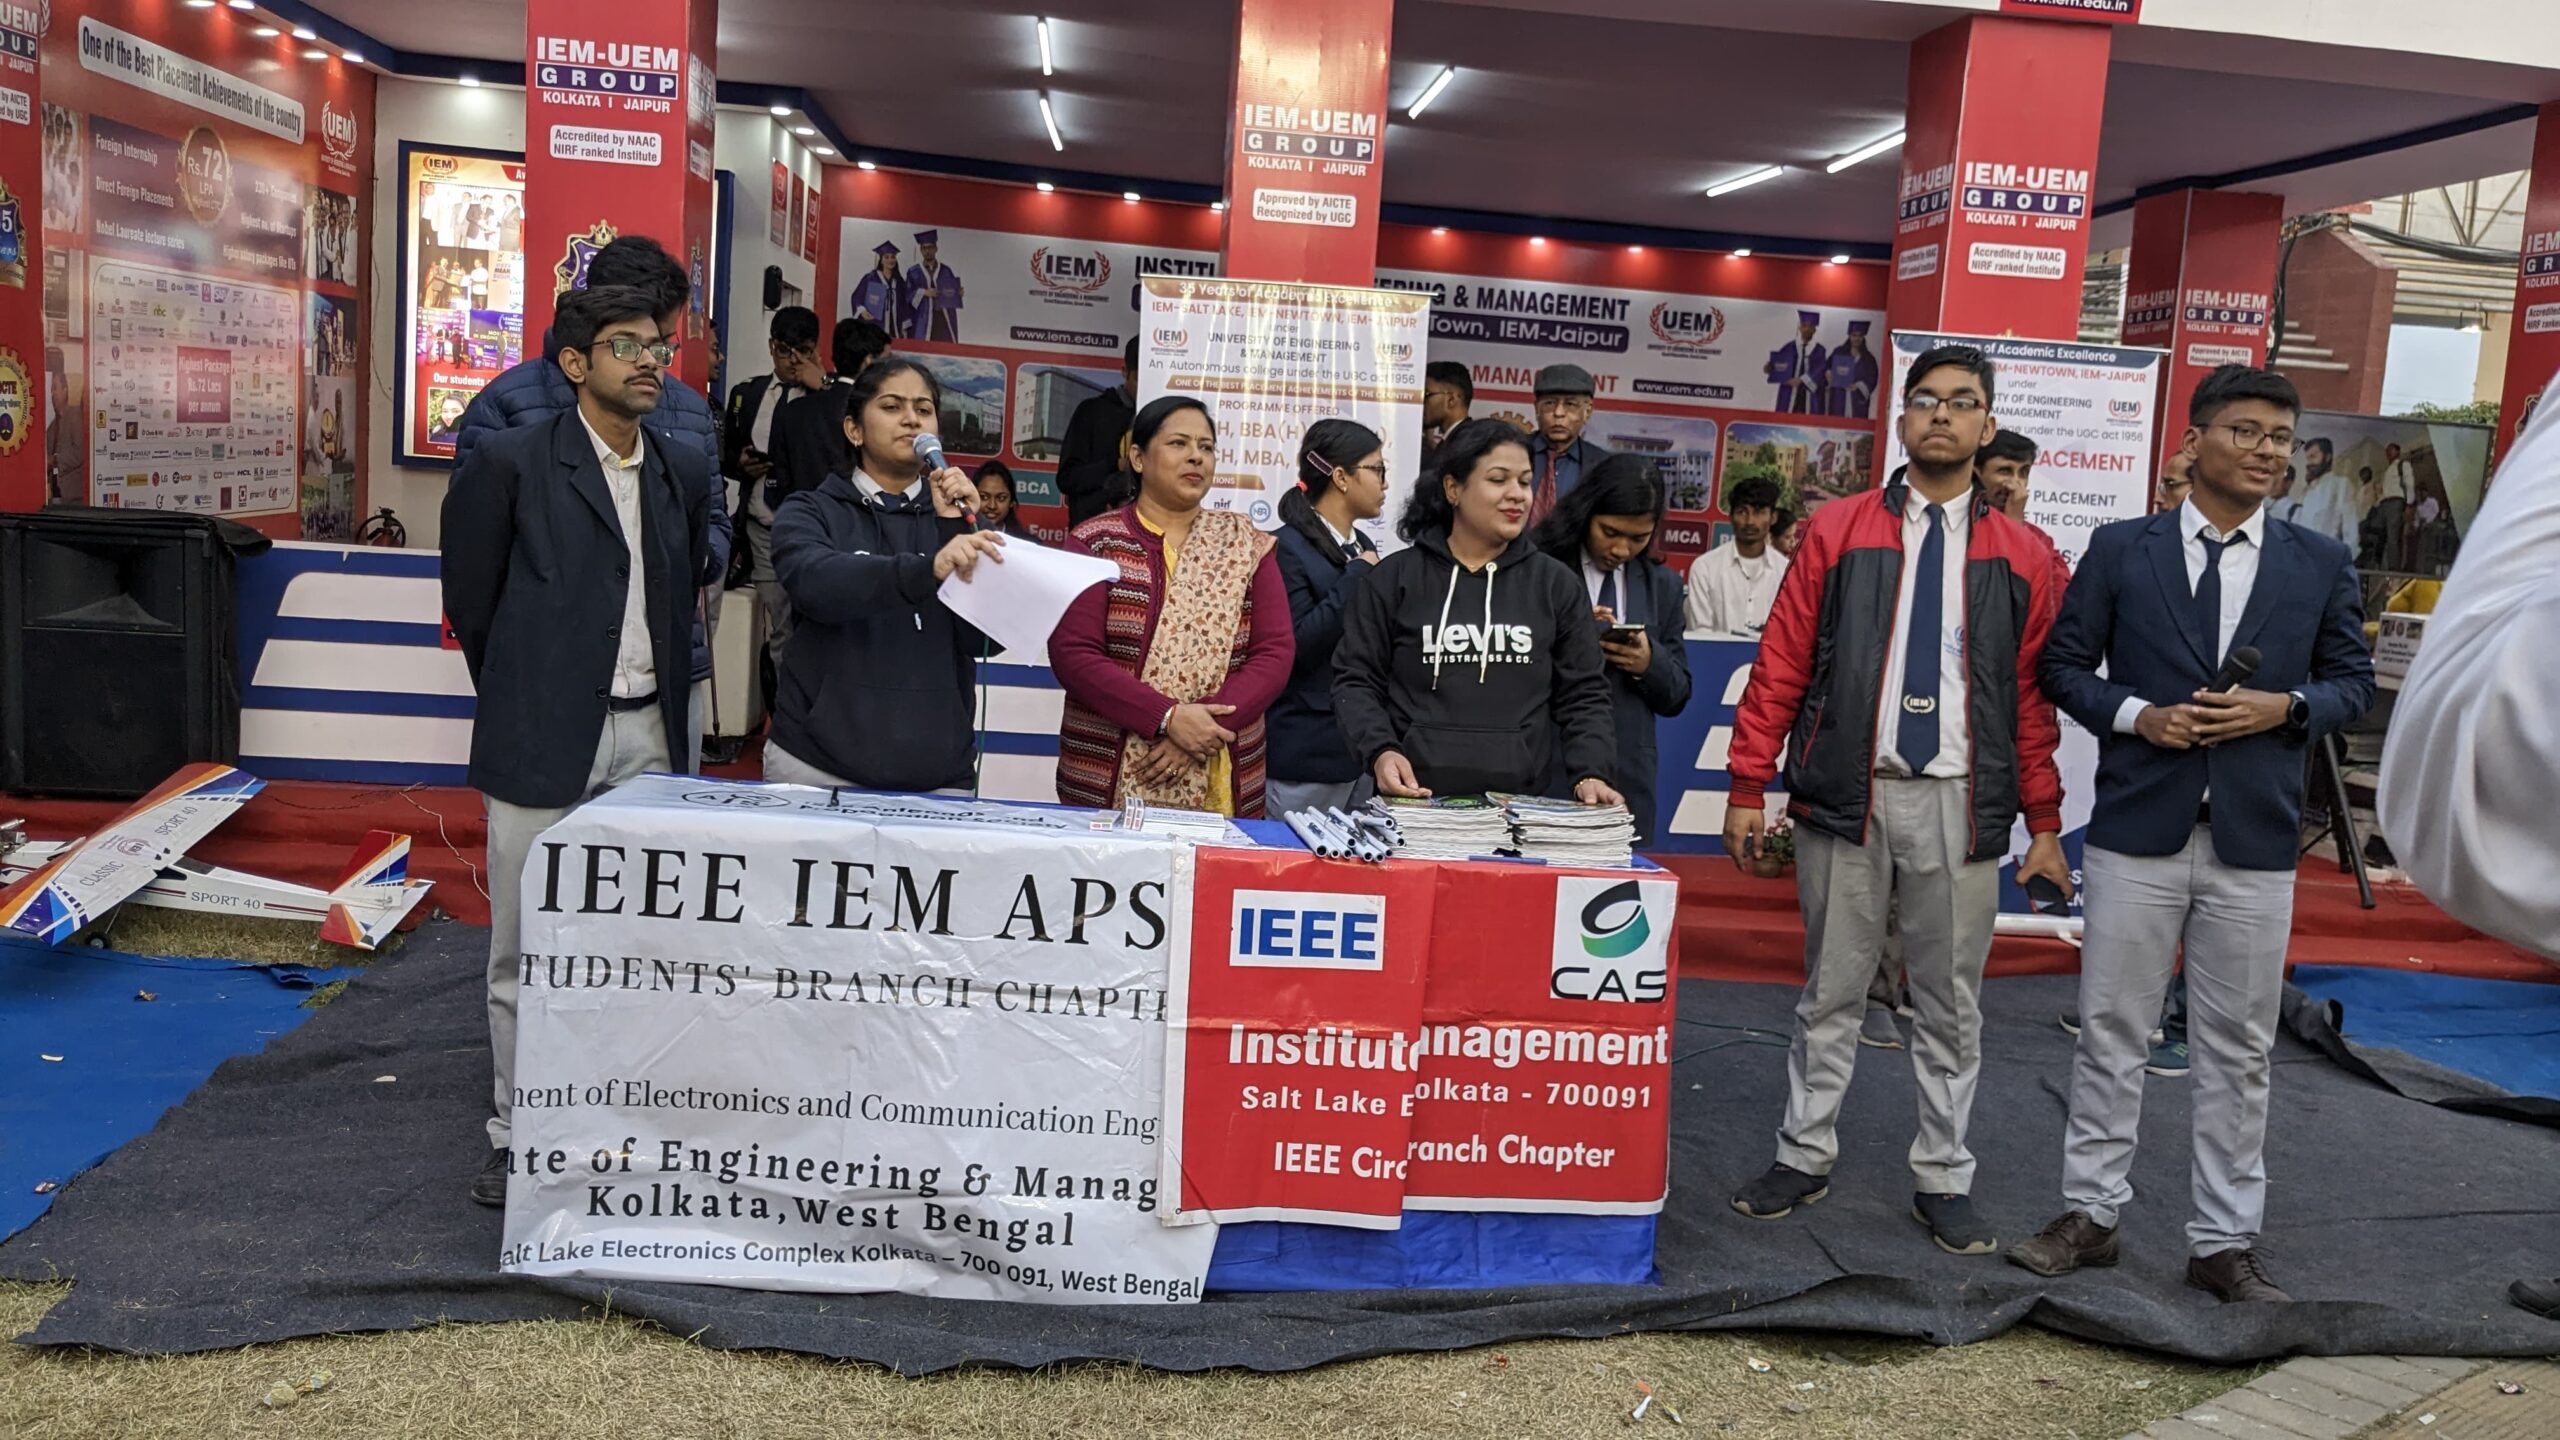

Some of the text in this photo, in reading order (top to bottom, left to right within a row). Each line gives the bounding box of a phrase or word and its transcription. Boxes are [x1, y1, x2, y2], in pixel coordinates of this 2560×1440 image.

[537, 36, 679, 71] IEM-UEM
[9, 58, 34, 74] JAIPUR
[83, 26, 301, 137] One of the Best Placement Achievements of the country
[541, 67, 674, 93] GROUP
[10, 93, 28, 107] AICTE
[543, 91, 670, 113] KOLKATA JAIPUR
[16, 108, 28, 121] UGC
[1244, 103, 1376, 136] IEM-UEM
[327, 112, 352, 143] UEM
[555, 129, 656, 148] Accredited by NAAC
[1248, 134, 1371, 158] GROUP
[96, 134, 158, 167] Foreign Internship
[554, 143, 657, 163] NIRF ranked Institute
[429, 158, 452, 169] IEM
[1248, 156, 1366, 176] KOLKATA JAIPUR
[1901, 162, 1953, 197] IEM-UEM
[1964, 161, 2088, 192] IEM-UEM
[96, 176, 114, 194] Direct
[117, 181, 139, 202] Foreign
[141, 187, 174, 208] Placements
[200, 183, 214, 196] LPA
[1259, 192, 1351, 209] Approved by AICTE
[1901, 190, 1949, 218] GROUP
[1967, 189, 2082, 213] GROUP
[1256, 206, 1351, 224] Recognized by UGC
[1966, 212, 2076, 231] KOLKATA JAIPUR
[96, 220, 114, 236] Nobel
[117, 224, 144, 242] Laureate
[167, 234, 184, 250] series
[1973, 246, 2061, 263] Accredited by NAAC
[1046, 254, 1096, 278] IEM
[1971, 260, 2061, 277] NIRF ranked Institute
[1179, 282, 1235, 298] 35 Years
[2525, 276, 2559, 288] KOLKATA
[1454, 285, 1469, 307] &
[1476, 287, 1630, 321] MANAGEMENT
[2128, 289, 2174, 310] IEM-UEM
[2186, 289, 2267, 310] IEM-UEM
[1152, 301, 1244, 318] IEM-SALT LAKE,
[2127, 308, 2172, 324] GROUP
[2187, 308, 2263, 324] GROUP
[1662, 310, 1712, 332] UEM
[2186, 323, 2260, 336] KOLKATA JAIPUR
[1016, 329, 1113, 346] www.iem.edu.in
[1159, 329, 1182, 342] IEM
[1430, 314, 1623, 348] Town, IEM-Jaipur
[1208, 332, 1360, 351] UNIVERSITY OF ENGINEERING
[1382, 343, 1408, 356] UEM
[1250, 349, 1327, 363] MANAGEMENT
[1984, 343, 1995, 354] of
[1997, 344, 2055, 358] Academic
[2057, 348, 2117, 362] Excellence
[433, 371, 485, 387] Our students
[1149, 359, 1164, 369] An
[1169, 360, 1241, 374] Autonomous
[1243, 365, 1284, 378] college
[1342, 371, 1368, 381] UGC
[2081, 368, 2147, 383] IEM-JAIPUR
[1636, 382, 1730, 398] www.uem.edu.in
[2008, 380, 2037, 389] under
[1219, 400, 1340, 416] PROGRAMME OFFERED
[2011, 394, 2092, 408] OF ENGINEERING
[2113, 401, 2137, 413] UEM
[1991, 407, 2061, 420] MANAGEMENT
[2024, 425, 2143, 442] under the UGC act 1956
[1244, 449, 1290, 469] MBA,
[1016, 480, 1050, 495] BCA
[2033, 490, 2117, 507] PLACEMENT
[2033, 512, 2125, 528] THE COUNT
[1665, 529, 1701, 544] MCA
[1515, 655, 1533, 664] CO.
[1909, 697, 1929, 707] IEM
[155, 806, 198, 836] SPORT 40
[80, 860, 124, 886] CLASSIC
[191, 891, 261, 909] SPORT 40
[538, 841, 1166, 950] IEEE IEM APS
[1239, 907, 1378, 961] IEEE
[772, 967, 972, 1008] BRANCH
[1551, 966, 1667, 1003] CAS
[1241, 1086, 1302, 1110] Salt
[1315, 1088, 1387, 1114] Lake
[1546, 1083, 1650, 1108] 700091
[585, 1079, 619, 1106] of
[623, 1080, 789, 1115] Electronics
[797, 1091, 852, 1119] and
[861, 1094, 1095, 1134] Communication
[1103, 1109, 1161, 1144] Eng
[1274, 1141, 1341, 1174] IEEE
[1408, 1134, 1487, 1162] ranch
[1499, 1134, 1616, 1173] Chapter
[591, 1136, 637, 1173] of
[658, 1140, 941, 1197] Engineering
[963, 1163, 992, 1196] &
[1013, 1165, 1158, 1212] Manag
[923, 1202, 1074, 1253] Bengal
[538, 1240, 594, 1263] Lake
[601, 1239, 737, 1261] Electronics
[743, 1241, 845, 1267] Complex
[851, 1243, 936, 1264] Kolkata
[961, 1251, 1001, 1275] 700
[1007, 1265, 1054, 1292] 091,
[1061, 1270, 1117, 1294] West
[1123, 1273, 1200, 1302] Bengal
